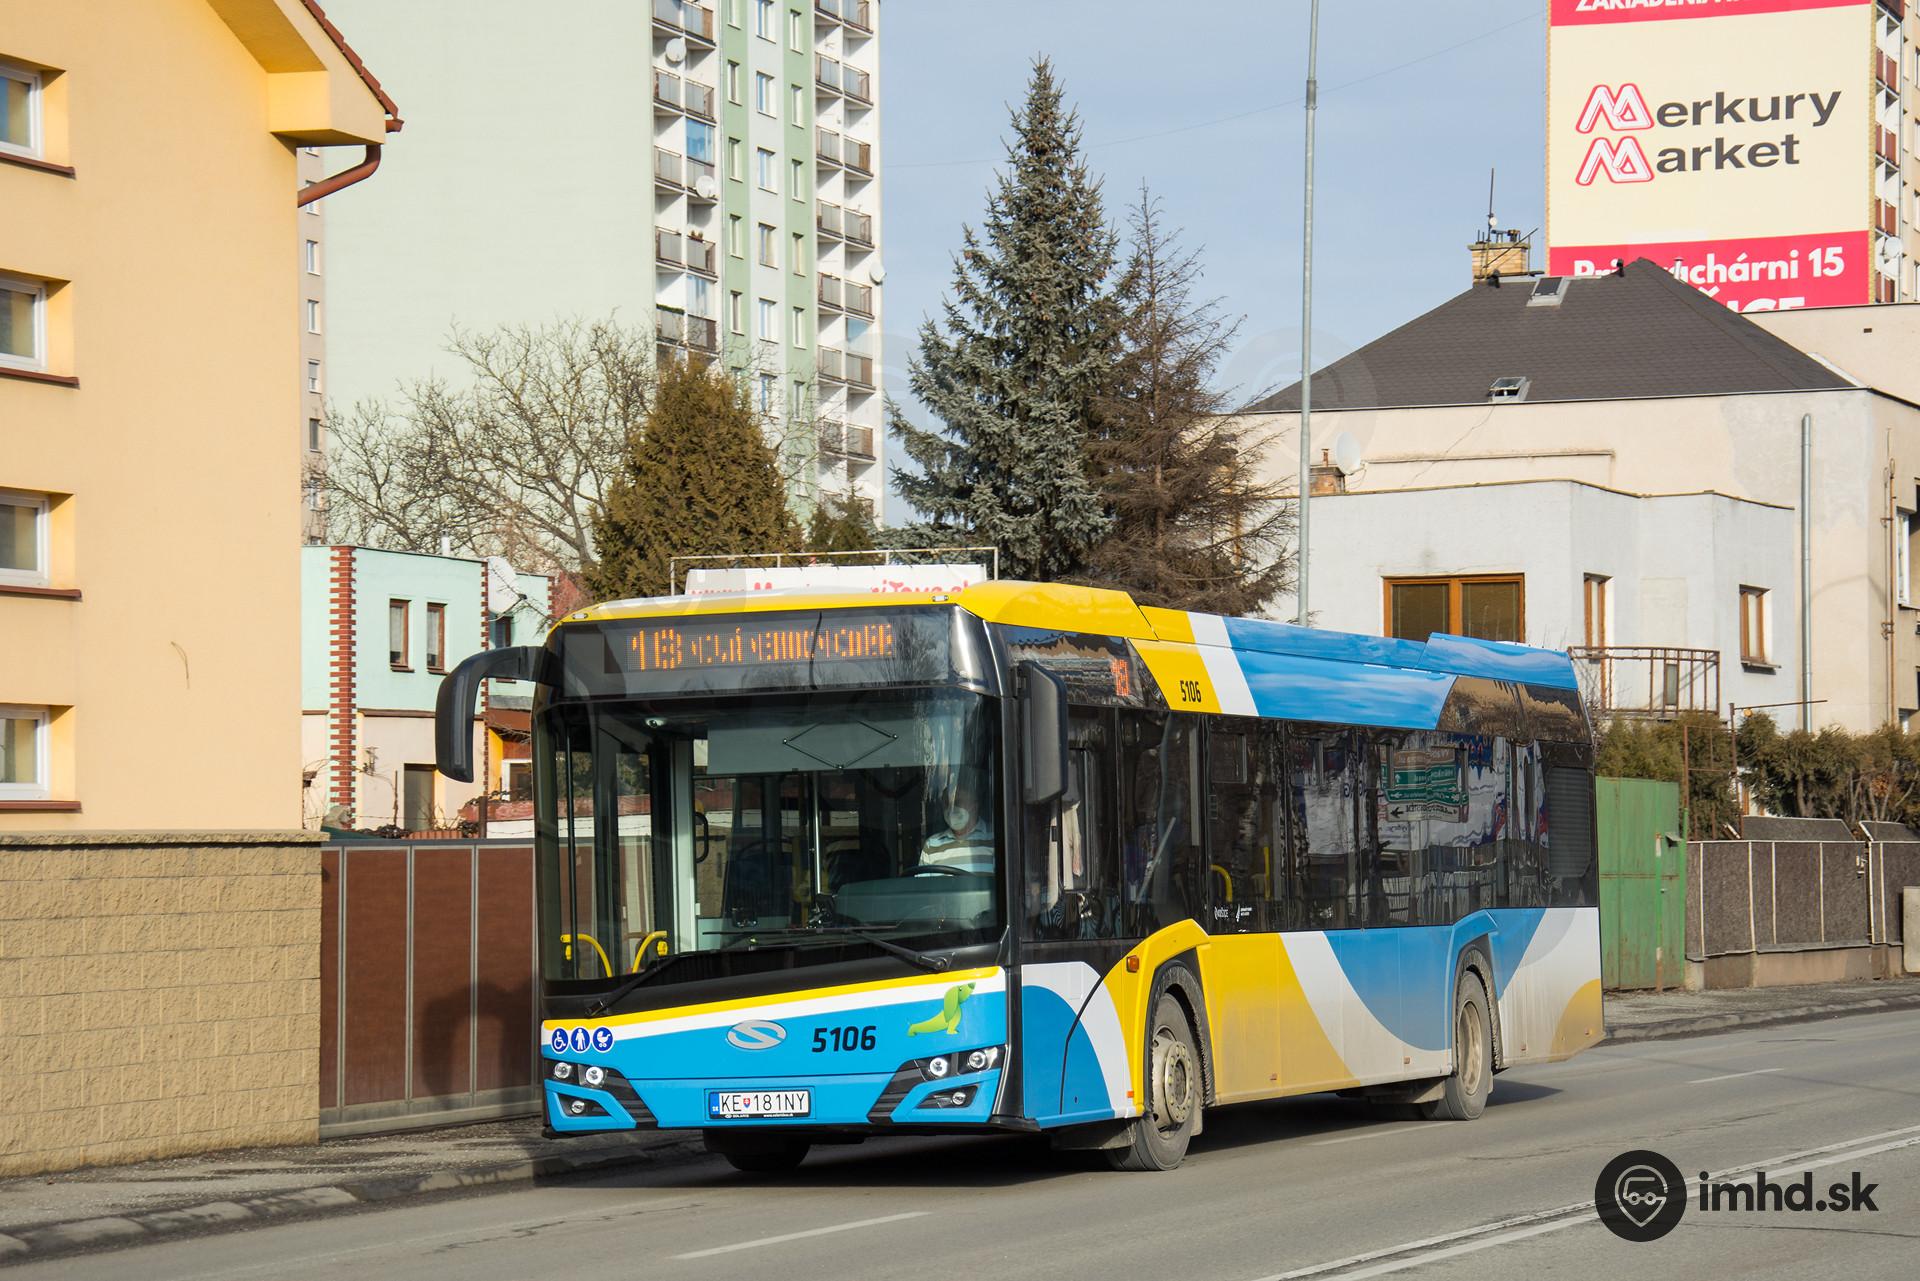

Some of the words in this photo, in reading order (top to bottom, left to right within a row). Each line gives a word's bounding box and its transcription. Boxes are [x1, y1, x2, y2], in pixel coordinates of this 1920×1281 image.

[1575, 83, 1842, 134] Merkury
[1575, 134, 1800, 186] Market
[1808, 246, 1845, 278] 15
[1179, 680, 1202, 703] 5106
[811, 1025, 877, 1053] 5106
